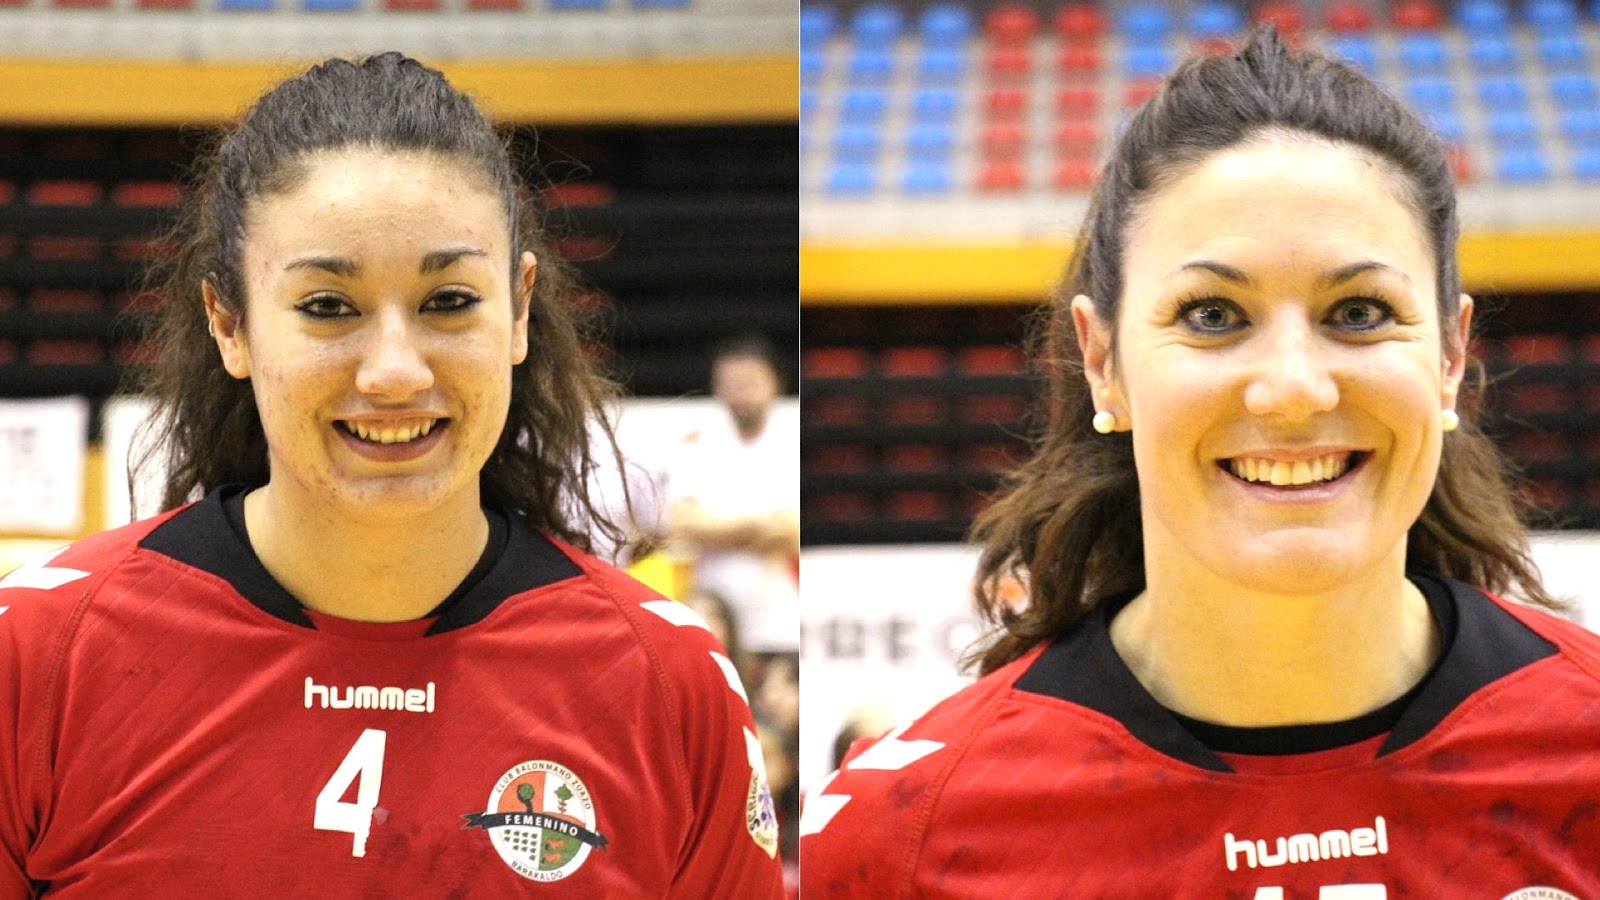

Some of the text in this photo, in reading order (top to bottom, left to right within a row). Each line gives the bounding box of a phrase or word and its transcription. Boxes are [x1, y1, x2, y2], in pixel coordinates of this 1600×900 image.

[304, 676, 435, 713] hummel
[313, 728, 387, 858] 4
[496, 763, 591, 810] CLUB BALONMANO ZUAZO
[504, 815, 578, 837] FEMENINO
[1224, 816, 1388, 871] hummel
[511, 860, 563, 881] BARAKALDO
